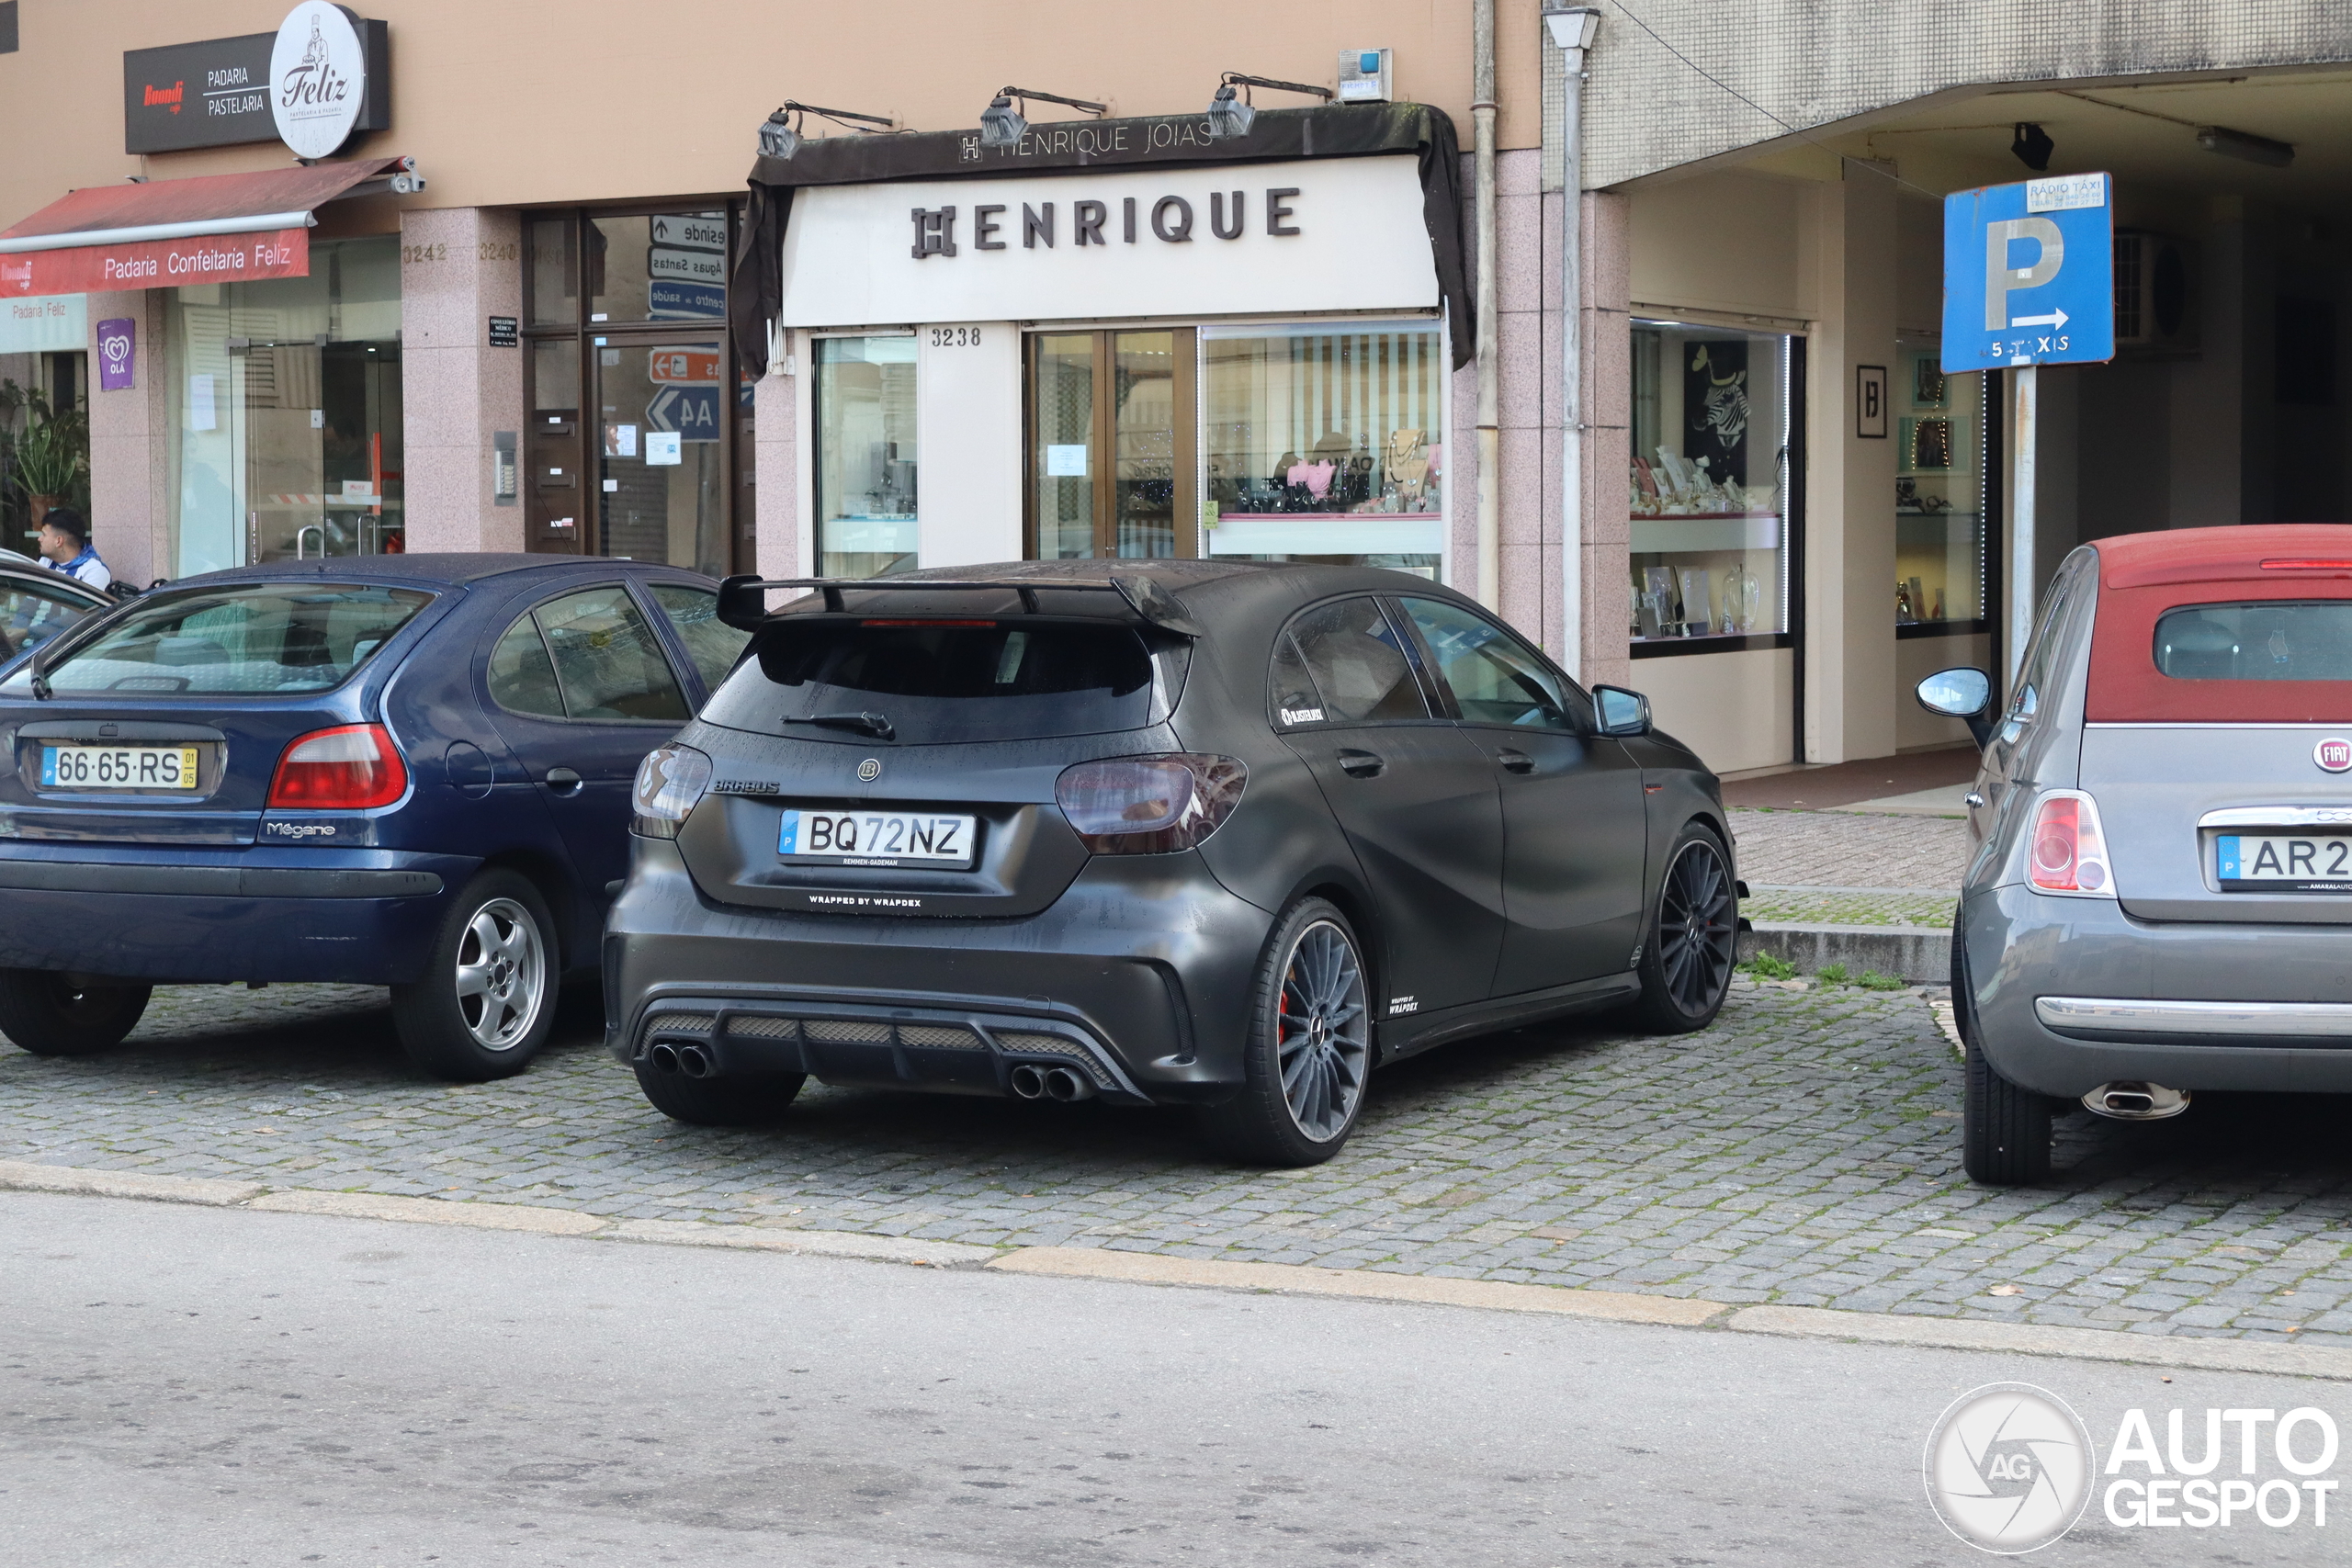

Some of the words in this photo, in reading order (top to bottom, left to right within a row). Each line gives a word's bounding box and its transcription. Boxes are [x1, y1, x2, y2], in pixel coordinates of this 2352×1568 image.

[208, 67, 248, 87] PADARIA
[281, 63, 349, 107] Feliz
[209, 95, 264, 116] PASTELARIA
[1144, 121, 1212, 153] JOIAS
[2030, 183, 2069, 197] RÁDIO
[2073, 179, 2100, 191] TÁXI
[911, 187, 1301, 259] HENRIQUE
[105, 256, 157, 279] Padaria
[167, 247, 244, 275] Confeitaria
[254, 243, 290, 267] Feliz
[403, 243, 447, 264] 3242
[1985, 217, 2064, 332] P
[13, 303, 42, 319] Padaria
[47, 301, 65, 317] Feliz
[932, 327, 981, 347] 3238
[1992, 342, 2003, 356] 5
[186, 753, 194, 763] 01
[2324, 746, 2347, 762] FIAT
[45, 770, 52, 779] P
[184, 773, 194, 784] 05
[714, 780, 780, 794] BRABUS
[266, 822, 335, 839] Mégane
[784, 837, 792, 847] P
[2252, 840, 2316, 875] AR
[2326, 840, 2349, 875] 2
[2225, 863, 2233, 872] P
[809, 896, 855, 905] WRAPPED
[858, 897, 870, 906] BY
[873, 898, 922, 908] WRAPDEX
[1389, 1001, 1419, 1014] WRAPDEX
